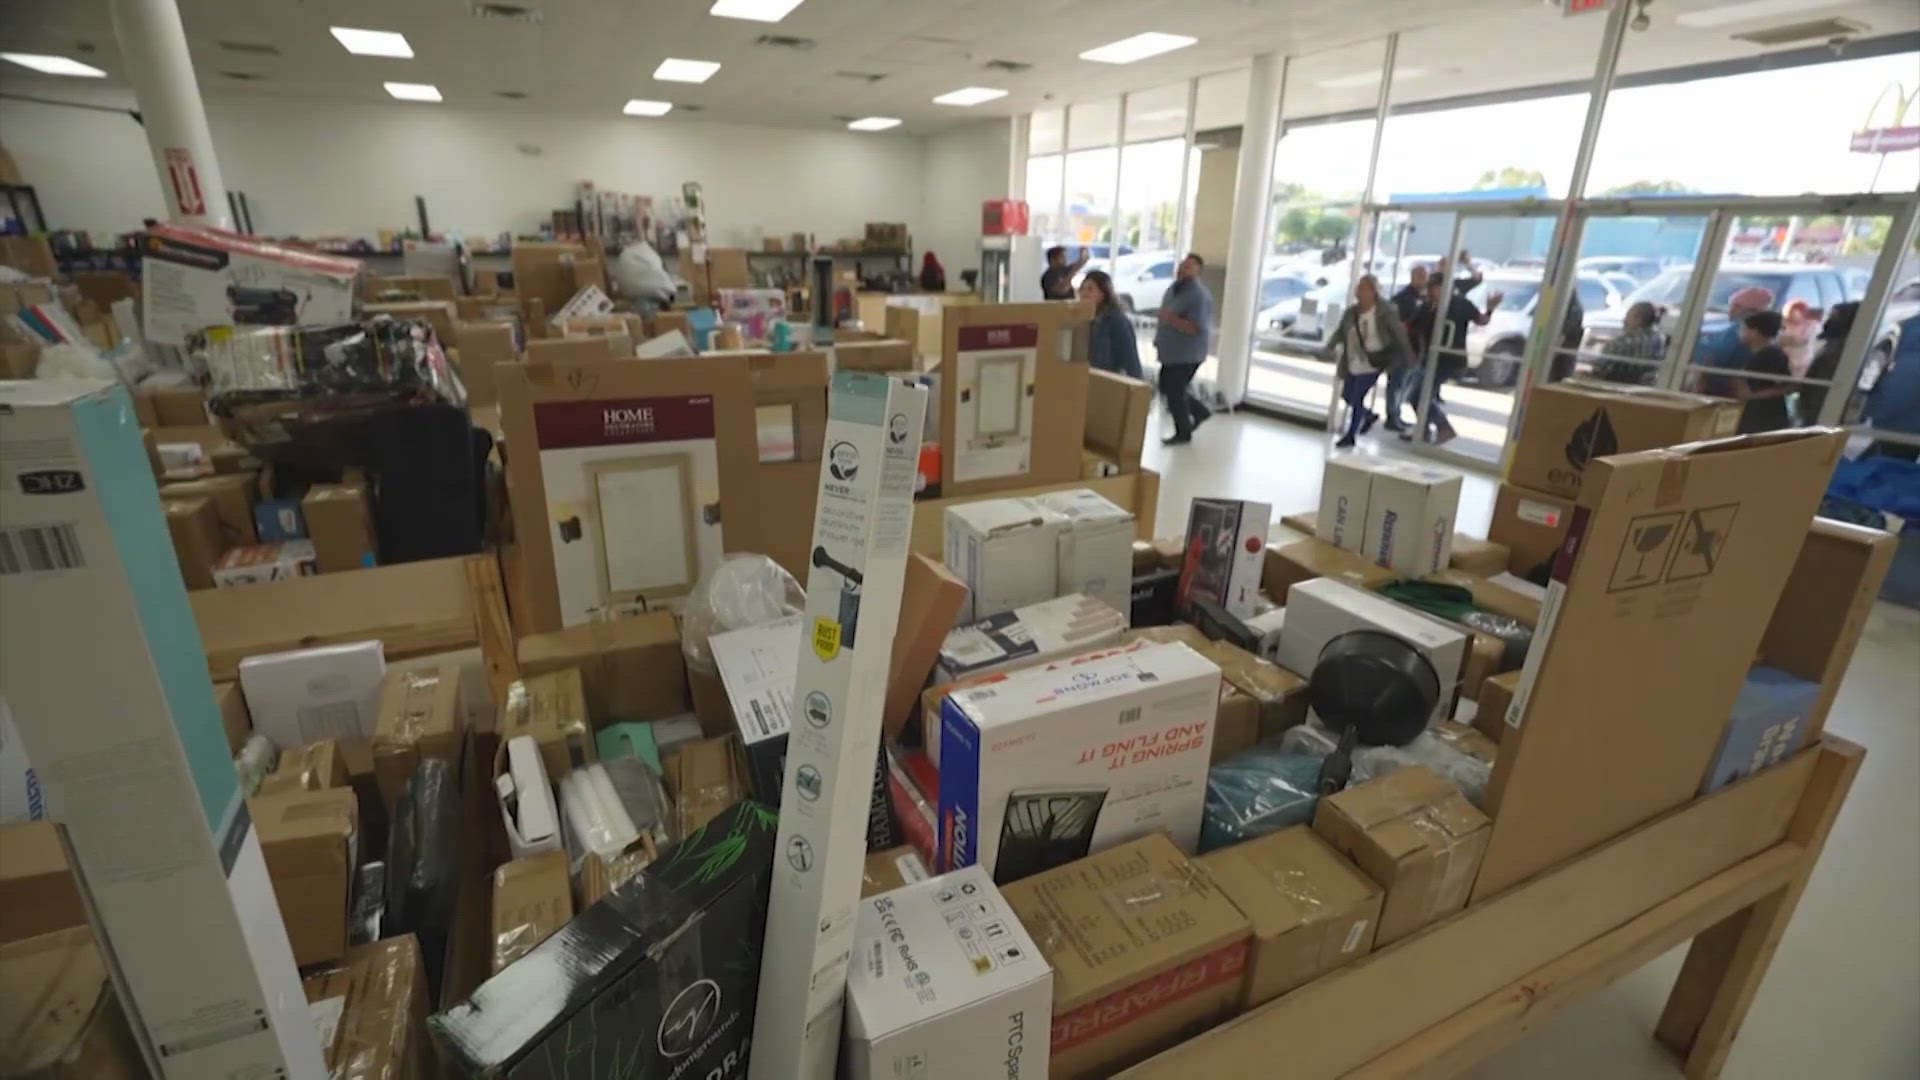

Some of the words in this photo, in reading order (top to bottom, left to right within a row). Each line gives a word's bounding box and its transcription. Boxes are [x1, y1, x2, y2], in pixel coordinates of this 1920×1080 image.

[603, 407, 655, 424] HOME
[1336, 495, 1349, 525] CAN
[816, 622, 838, 641] RUST
[1165, 720, 1209, 741] AND
[1101, 732, 1160, 759] FLING
[1131, 736, 1205, 764] SPRING
[1075, 747, 1097, 766] IT
[1107, 754, 1126, 770] IT
[1007, 1010, 1024, 1047] PTC
